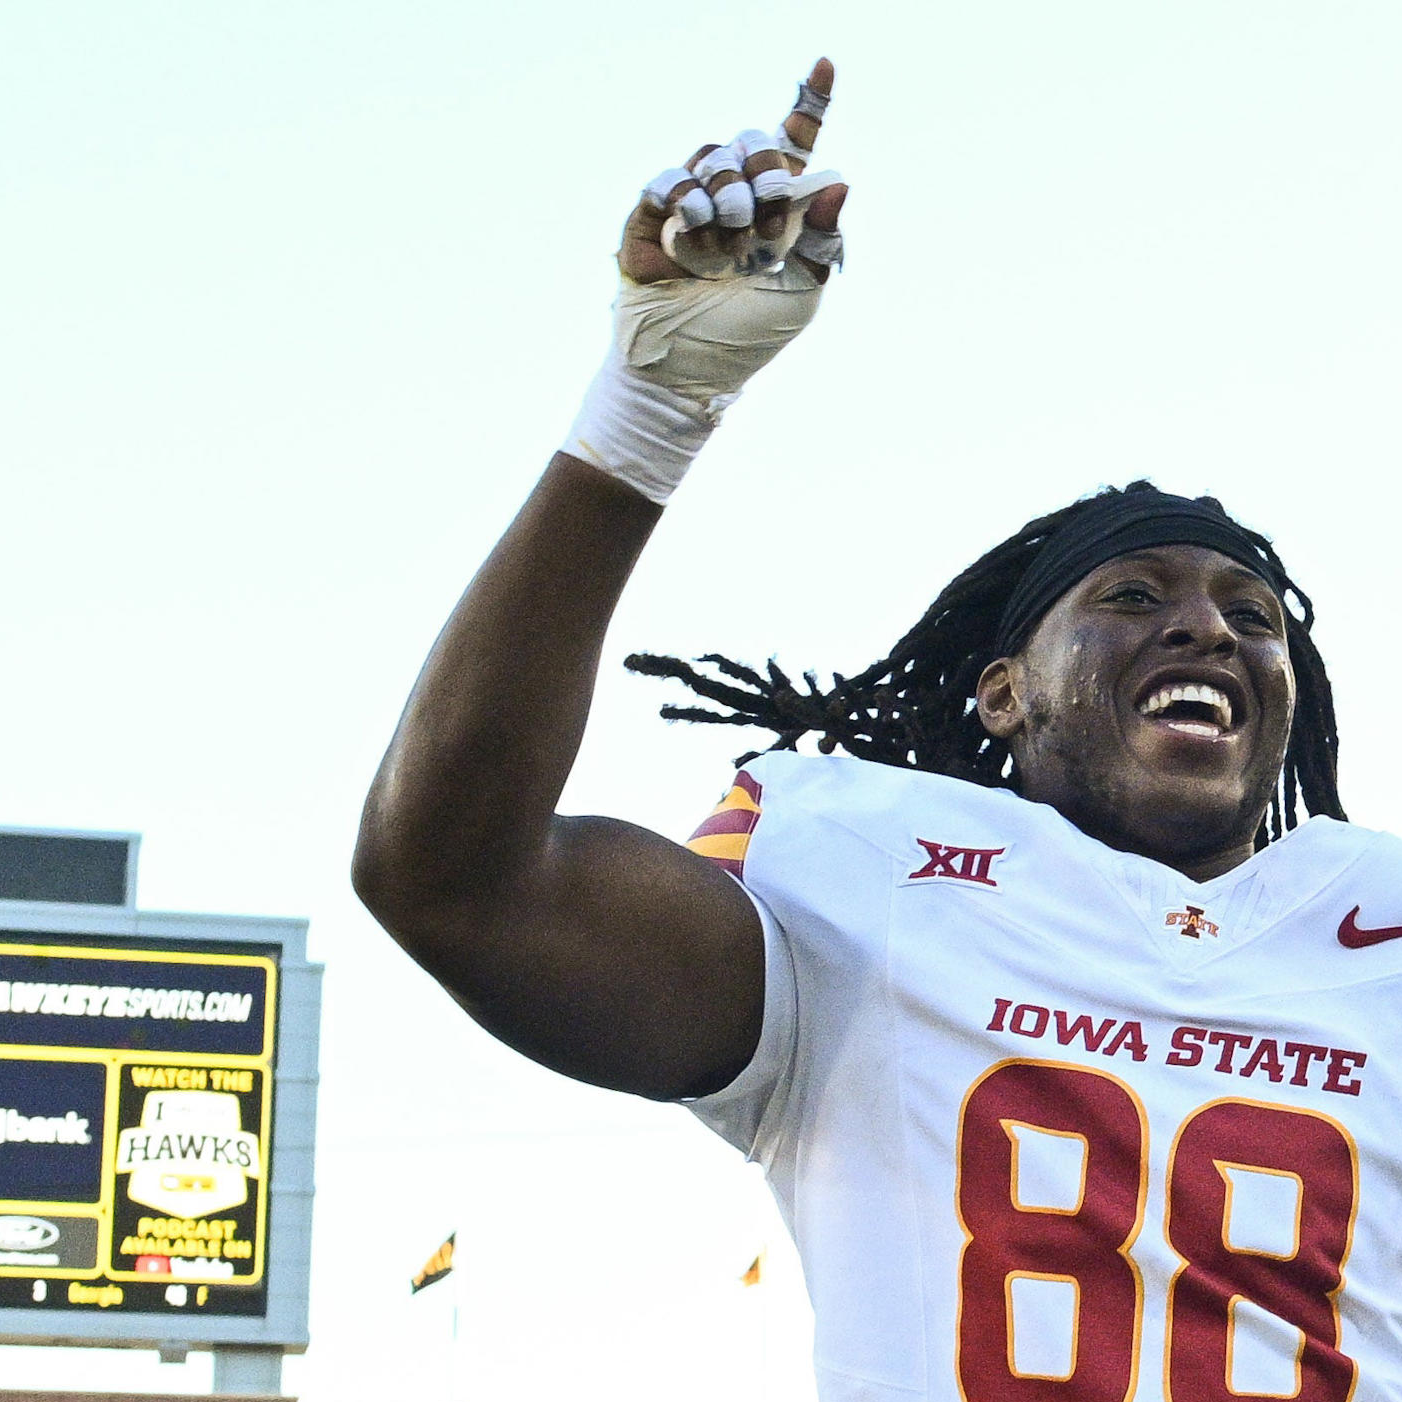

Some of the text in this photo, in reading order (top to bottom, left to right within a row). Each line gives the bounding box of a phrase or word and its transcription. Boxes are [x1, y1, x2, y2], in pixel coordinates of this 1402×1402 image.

[908, 838, 1006, 887] XII
[1165, 912, 1219, 938] STATE
[986, 998, 1368, 1097] IOWA STATE
[131, 1067, 254, 1092] WATCH THE
[126, 1134, 252, 1167] HAWKS
[138, 1217, 238, 1241] PODCAST
